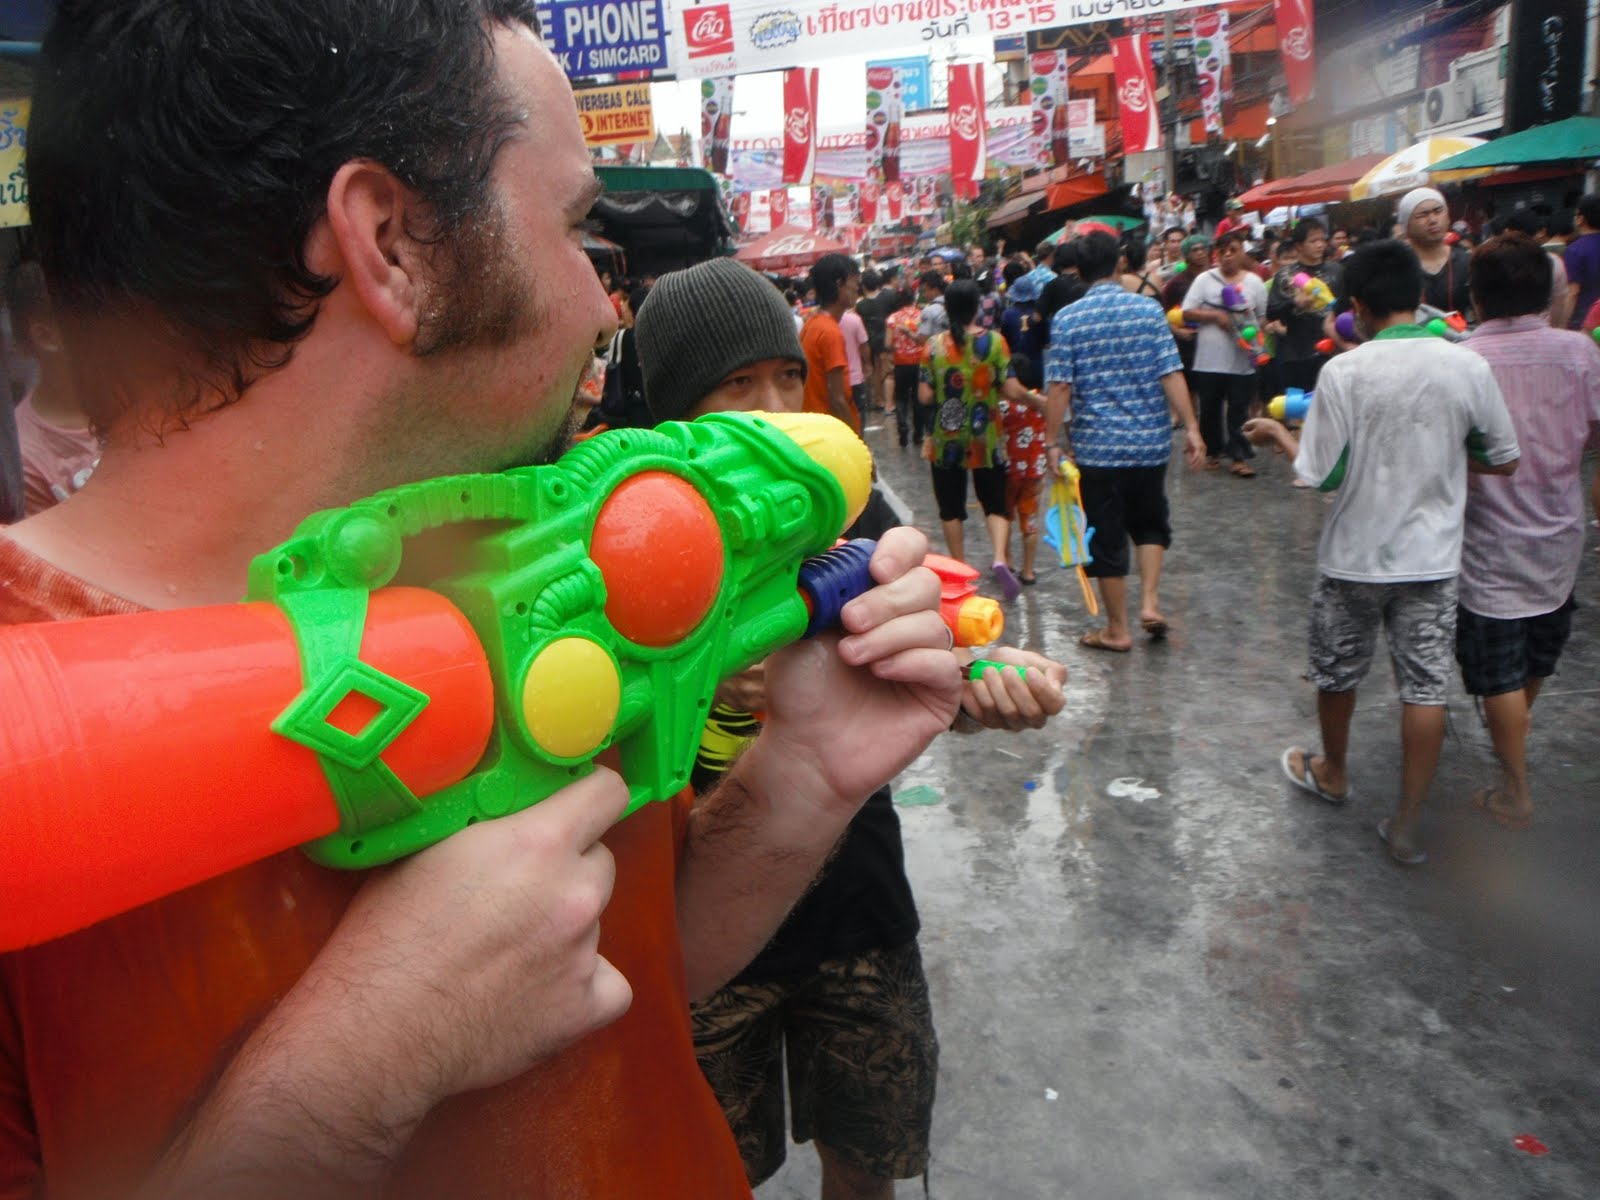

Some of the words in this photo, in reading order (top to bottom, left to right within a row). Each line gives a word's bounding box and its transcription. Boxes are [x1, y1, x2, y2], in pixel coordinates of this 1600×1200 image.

[564, 1, 659, 47] PHONE
[921, 13, 970, 41] วันที่
[589, 44, 661, 69] SIMCARD
[575, 91, 622, 111] VERSEAS
[626, 88, 652, 107] CALL
[596, 110, 651, 131] INTERNET
